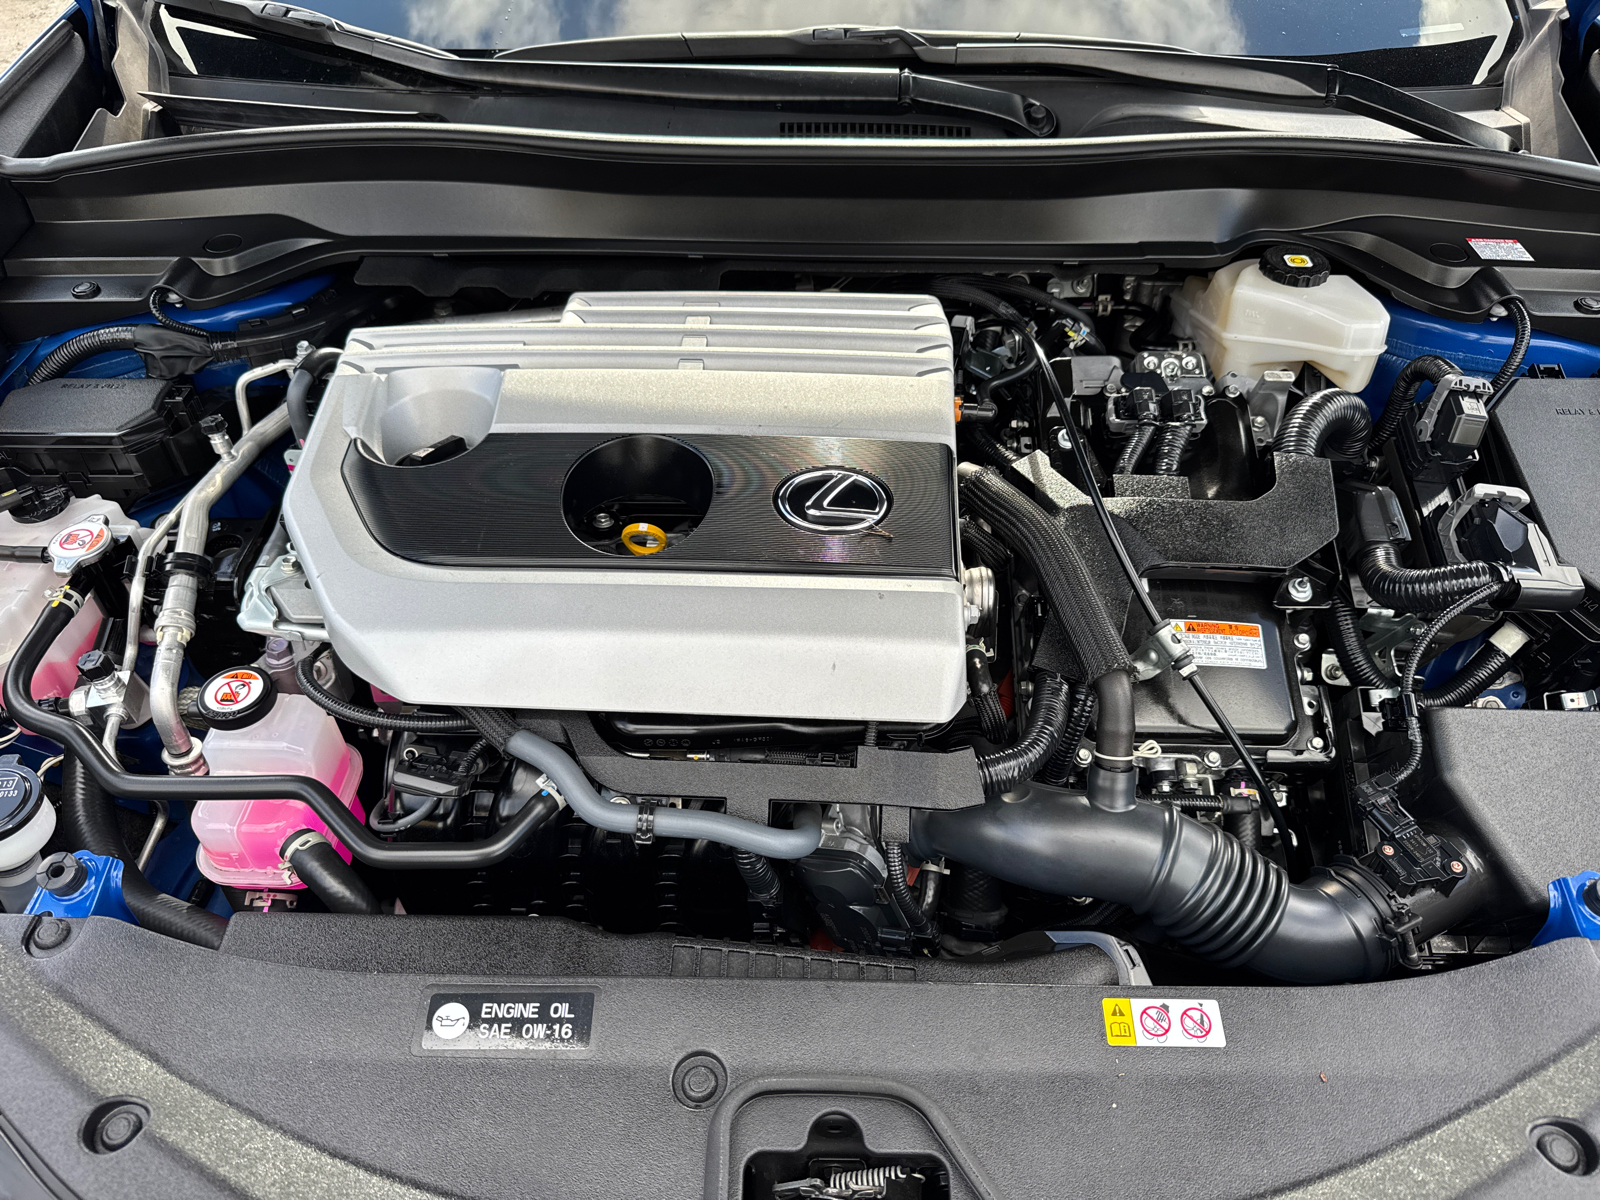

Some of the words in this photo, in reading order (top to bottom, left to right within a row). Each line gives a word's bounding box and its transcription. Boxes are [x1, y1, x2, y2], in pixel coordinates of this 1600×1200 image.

[0, 780, 14, 788] 13
[481, 1003, 540, 1018] ENGINE
[550, 1003, 575, 1018] OIL
[479, 1024, 511, 1038] SAE
[522, 1024, 573, 1038] 0W-16
